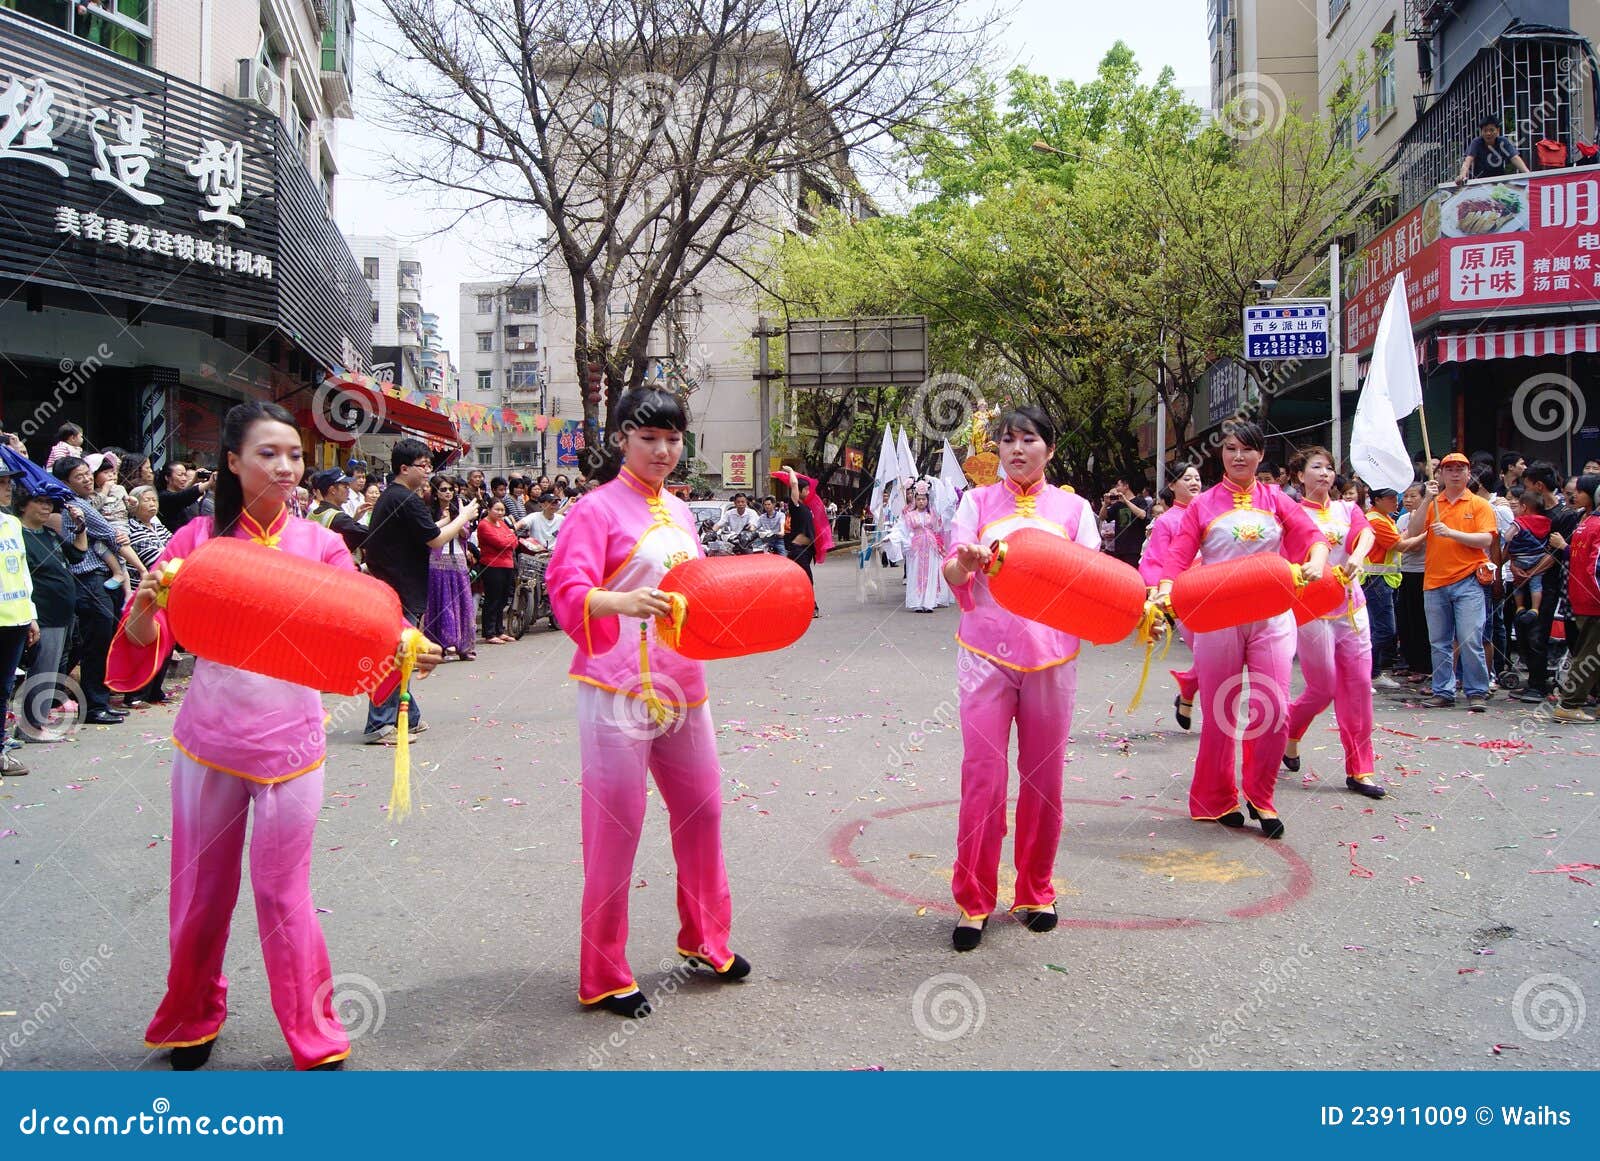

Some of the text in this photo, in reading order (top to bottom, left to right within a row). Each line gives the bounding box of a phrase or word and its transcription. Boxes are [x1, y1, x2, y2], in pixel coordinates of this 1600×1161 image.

[1540, 180, 1598, 228] 明
[54, 206, 272, 279] 美容美发连锁设计机构
[1252, 319, 1322, 332] 西乡派出所
[1253, 340, 1322, 349] 27925110
[1253, 347, 1322, 356] 84455200
